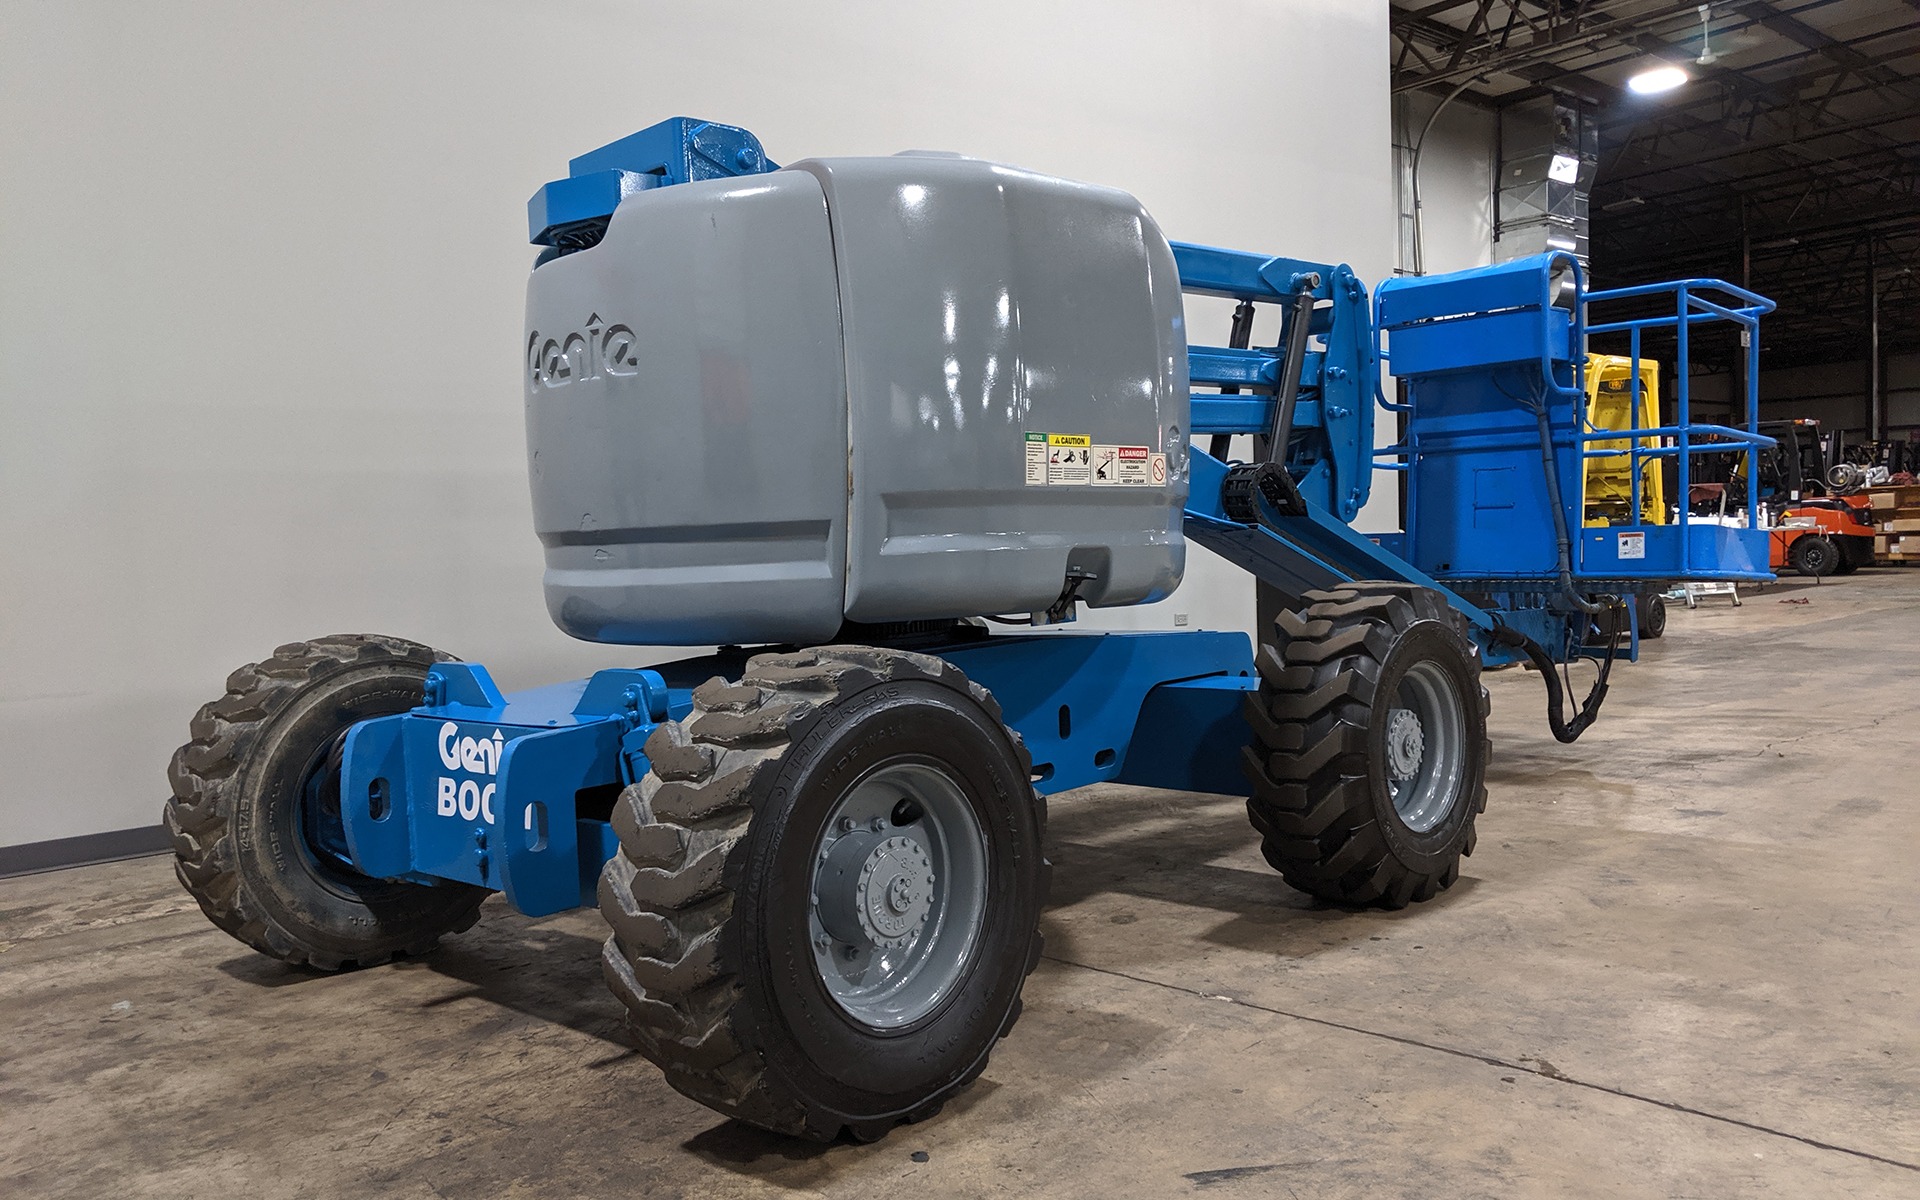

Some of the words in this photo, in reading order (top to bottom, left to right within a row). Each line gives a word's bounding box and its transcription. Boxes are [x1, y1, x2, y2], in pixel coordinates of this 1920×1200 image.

[1060, 437, 1086, 445] CAUTION
[1123, 450, 1147, 458] DANGER
[438, 721, 505, 775] Geni
